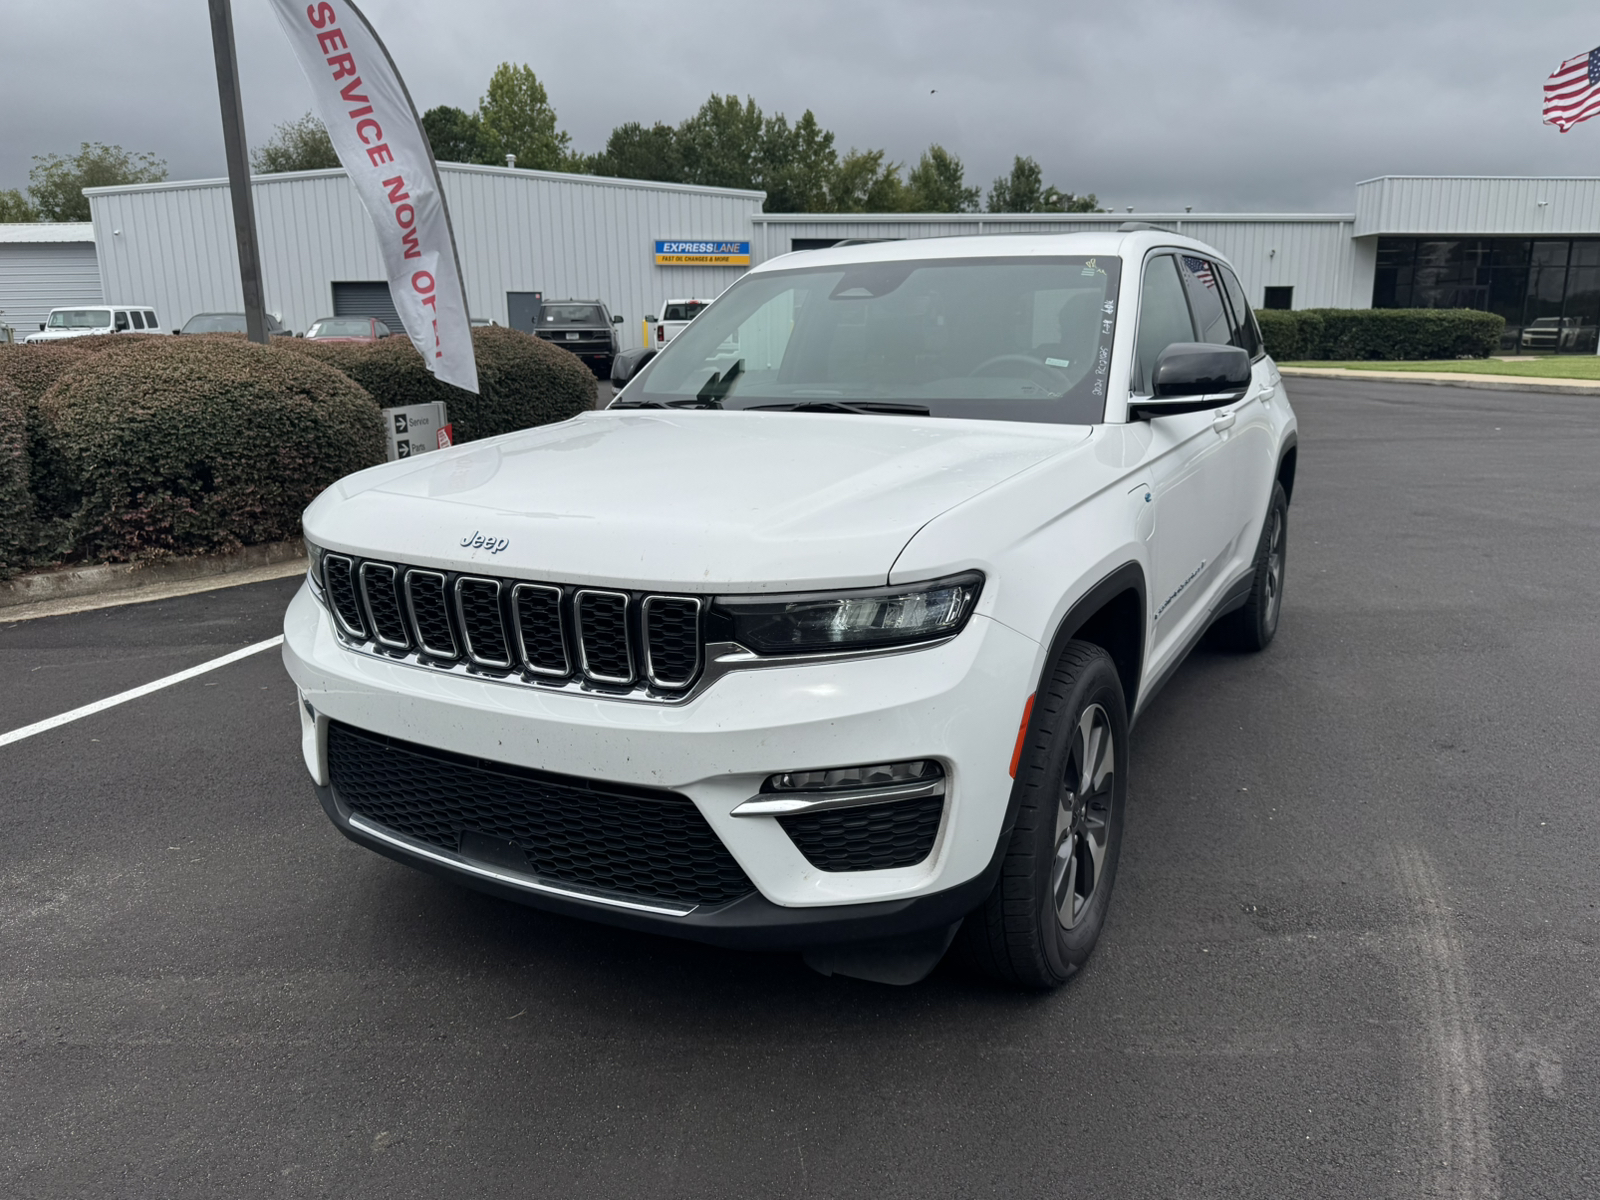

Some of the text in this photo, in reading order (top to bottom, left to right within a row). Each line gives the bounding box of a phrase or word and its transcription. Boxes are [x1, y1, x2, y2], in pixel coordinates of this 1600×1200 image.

[306, 1, 394, 168] SERVICE
[382, 175, 422, 260] NOW
[409, 418, 429, 427] Service
[412, 444, 425, 452] Parts
[460, 530, 510, 555] Jeep
